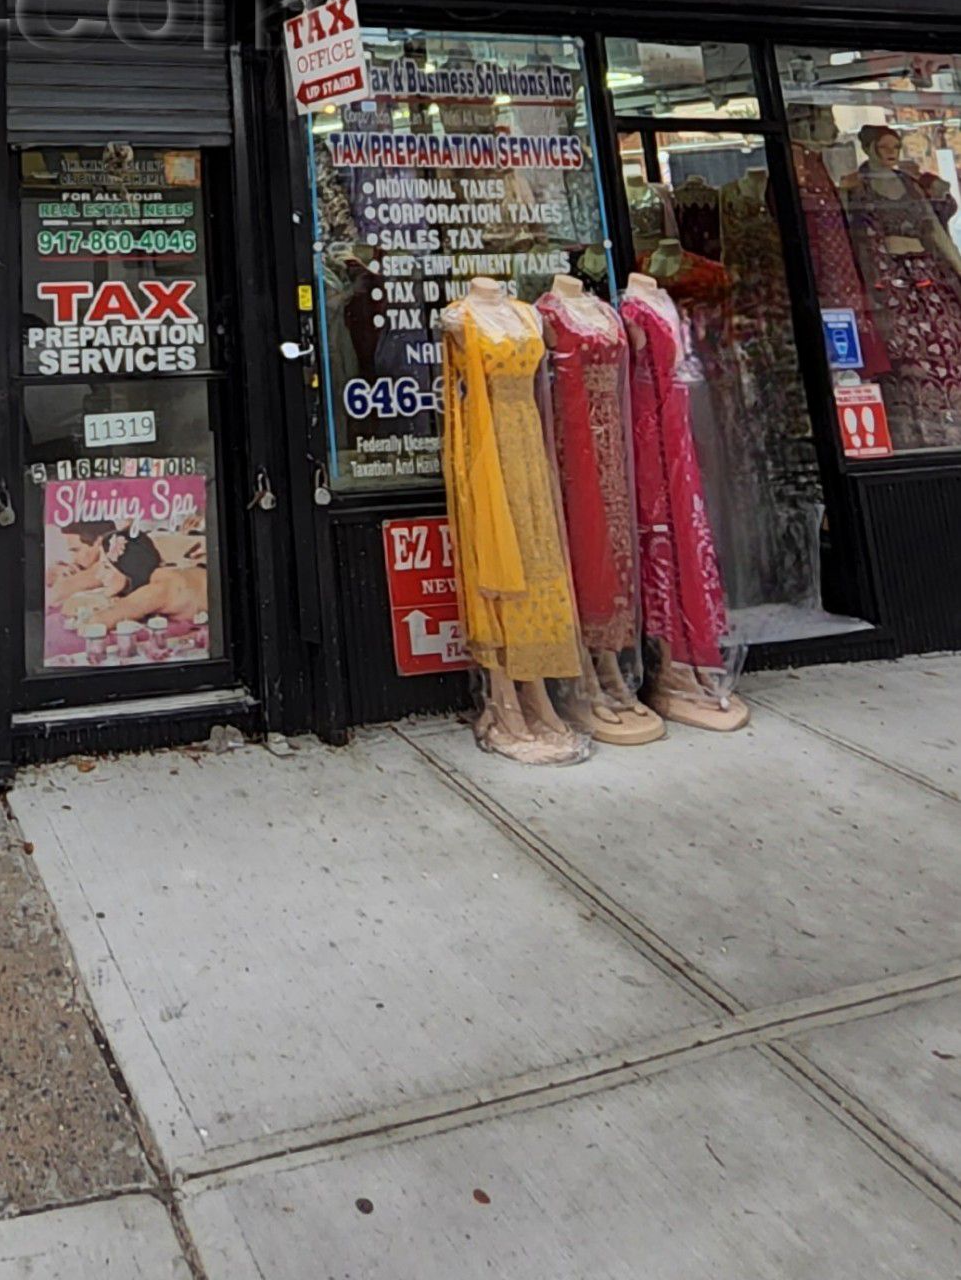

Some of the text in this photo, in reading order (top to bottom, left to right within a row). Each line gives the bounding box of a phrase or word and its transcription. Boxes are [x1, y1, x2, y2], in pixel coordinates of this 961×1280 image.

[296, 38, 355, 74] OFFICE
[392, 60, 404, 93] &
[405, 59, 474, 94] Business
[547, 68, 572, 98] Inc
[305, 86, 321, 100] UP
[329, 132, 583, 170] TAX PREPARATION SERVICES
[62, 192, 90, 201] FOR
[95, 192, 121, 201] ALL
[375, 179, 505, 200] INDIVIDUAL TAXES
[39, 202, 194, 218] REAL ESTATE NEEDS
[378, 203, 562, 224] CORPORATION TAXES
[38, 230, 196, 254] 917-860-4046
[380, 228, 484, 250] SALES TAX
[516, 252, 571, 275] TAXES
[38, 281, 198, 325] TAX
[385, 281, 415, 303] TAX
[423, 281, 439, 301] ID
[387, 308, 422, 330] TAX
[28, 324, 205, 348] PREPARATION
[38, 347, 197, 375] SERVICES
[89, 417, 152, 441] 11319
[54, 480, 198, 538] Shining Spa
[391, 526, 432, 570] EZ
